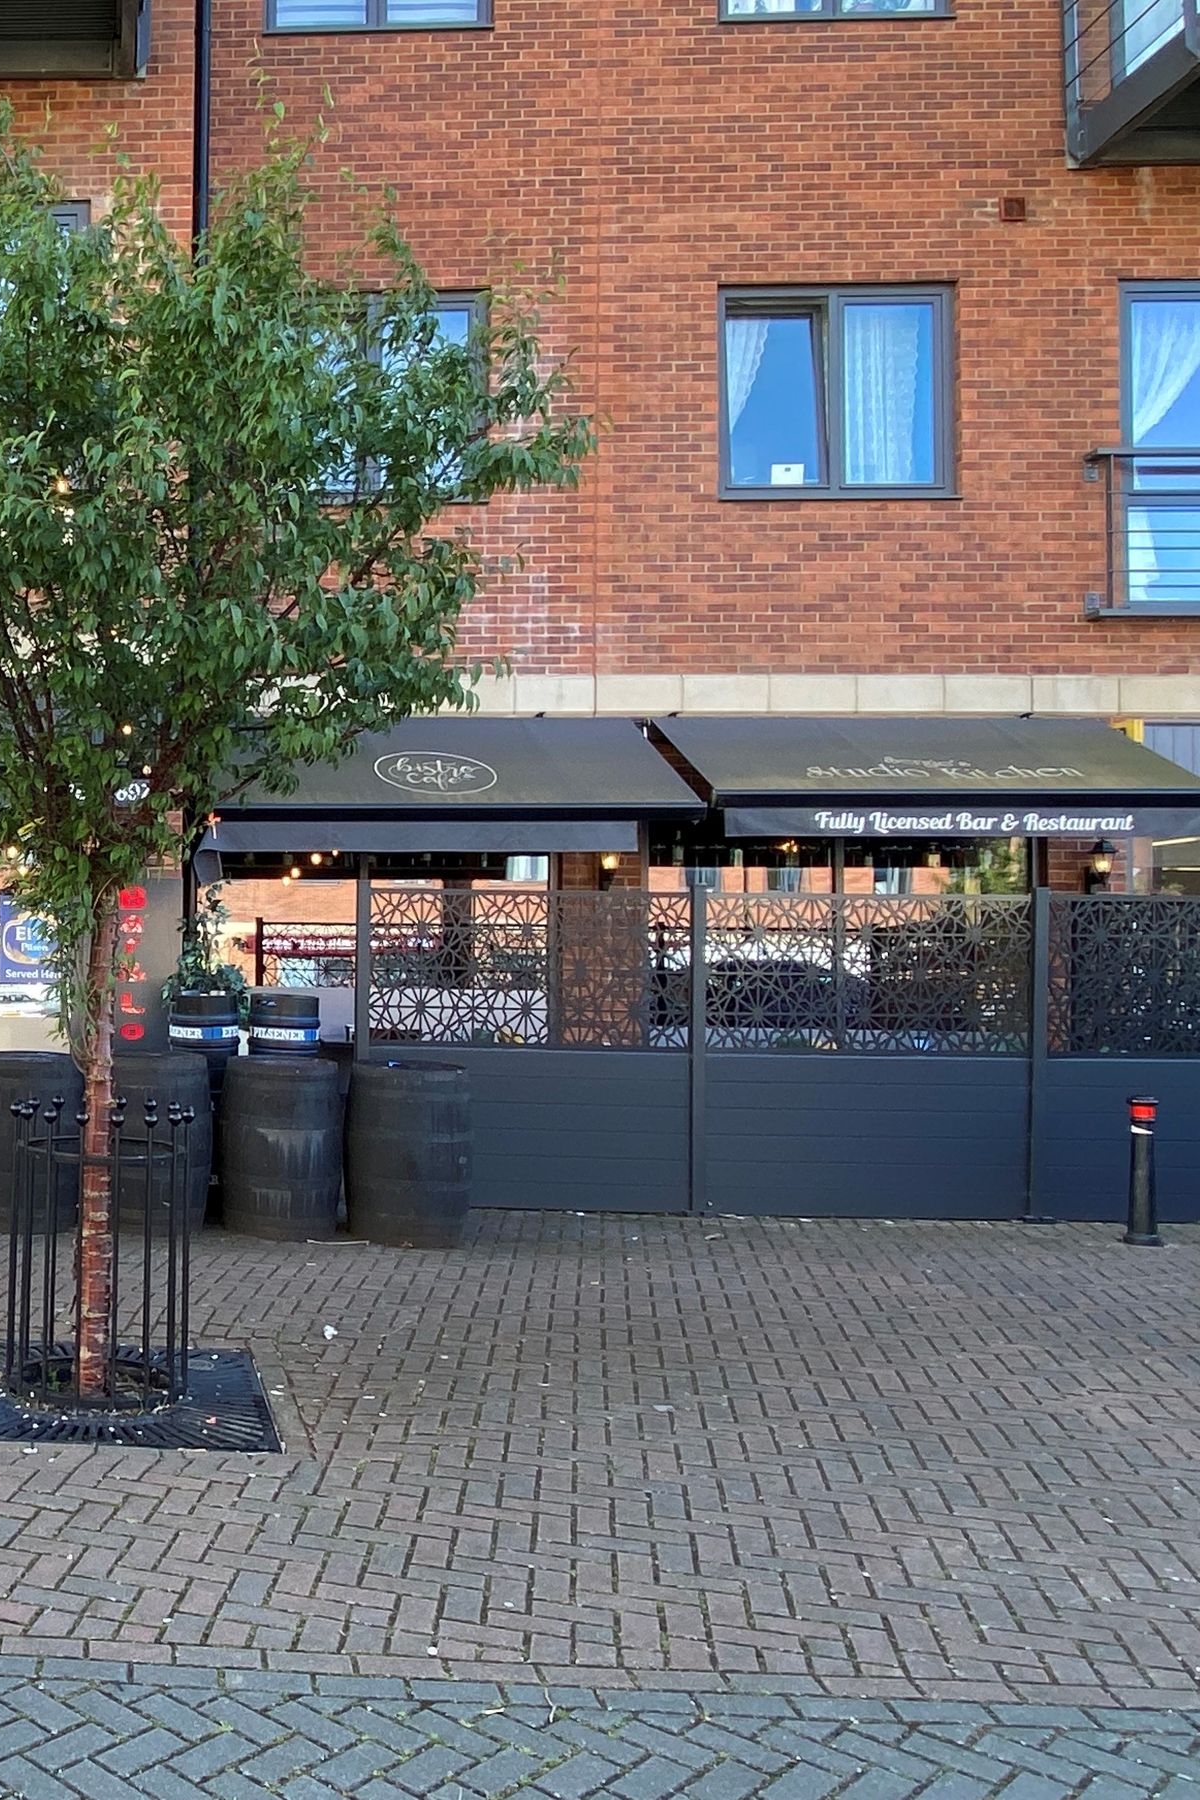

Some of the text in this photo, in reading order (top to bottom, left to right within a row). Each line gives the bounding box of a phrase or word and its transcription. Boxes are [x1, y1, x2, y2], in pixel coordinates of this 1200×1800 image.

[940, 764, 1085, 780] Kitchen
[814, 811, 1135, 834] Fully Licensed Bar & Restaurant
[5, 968, 39, 979] Served
[253, 1028, 306, 1041] PILSENER
